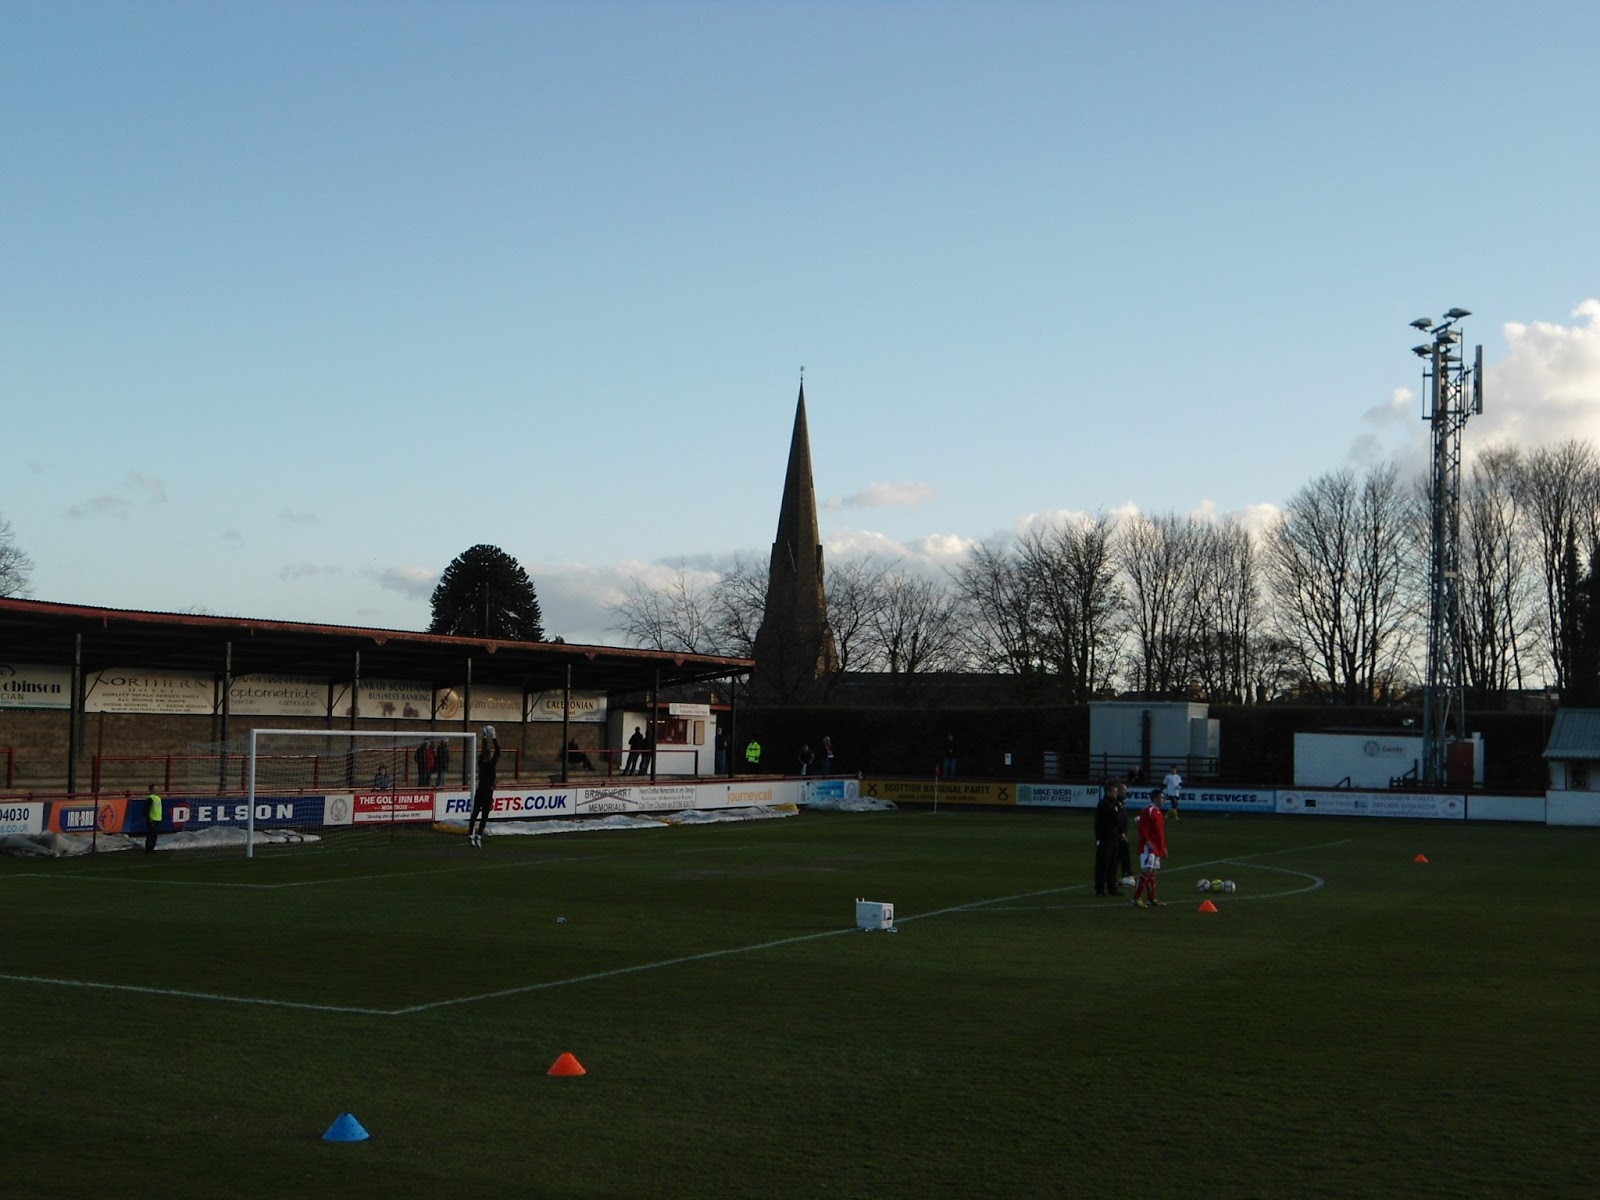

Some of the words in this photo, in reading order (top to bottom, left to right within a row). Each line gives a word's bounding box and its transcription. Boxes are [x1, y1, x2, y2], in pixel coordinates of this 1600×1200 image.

[0, 681, 61, 693] obinson
[230, 687, 318, 699] optometrists
[368, 692, 400, 700] BUSINESS
[401, 693, 431, 701] BANKING
[546, 700, 594, 710] CALEONIAN
[884, 783, 921, 793] SCOTTISH
[964, 785, 990, 794] PARTY
[1033, 788, 1051, 796] MIKE
[1052, 788, 1072, 797] WEIR
[1086, 788, 1099, 796] MP
[359, 796, 376, 804] THE
[398, 795, 413, 804] INN
[414, 794, 430, 803] BAR
[726, 786, 772, 804] journeycall
[1201, 792, 1257, 803] SERVICES
[446, 795, 567, 813] FREETS.CO.UK
[589, 803, 627, 812] MEMORIALS
[172, 803, 294, 823] DELSON
